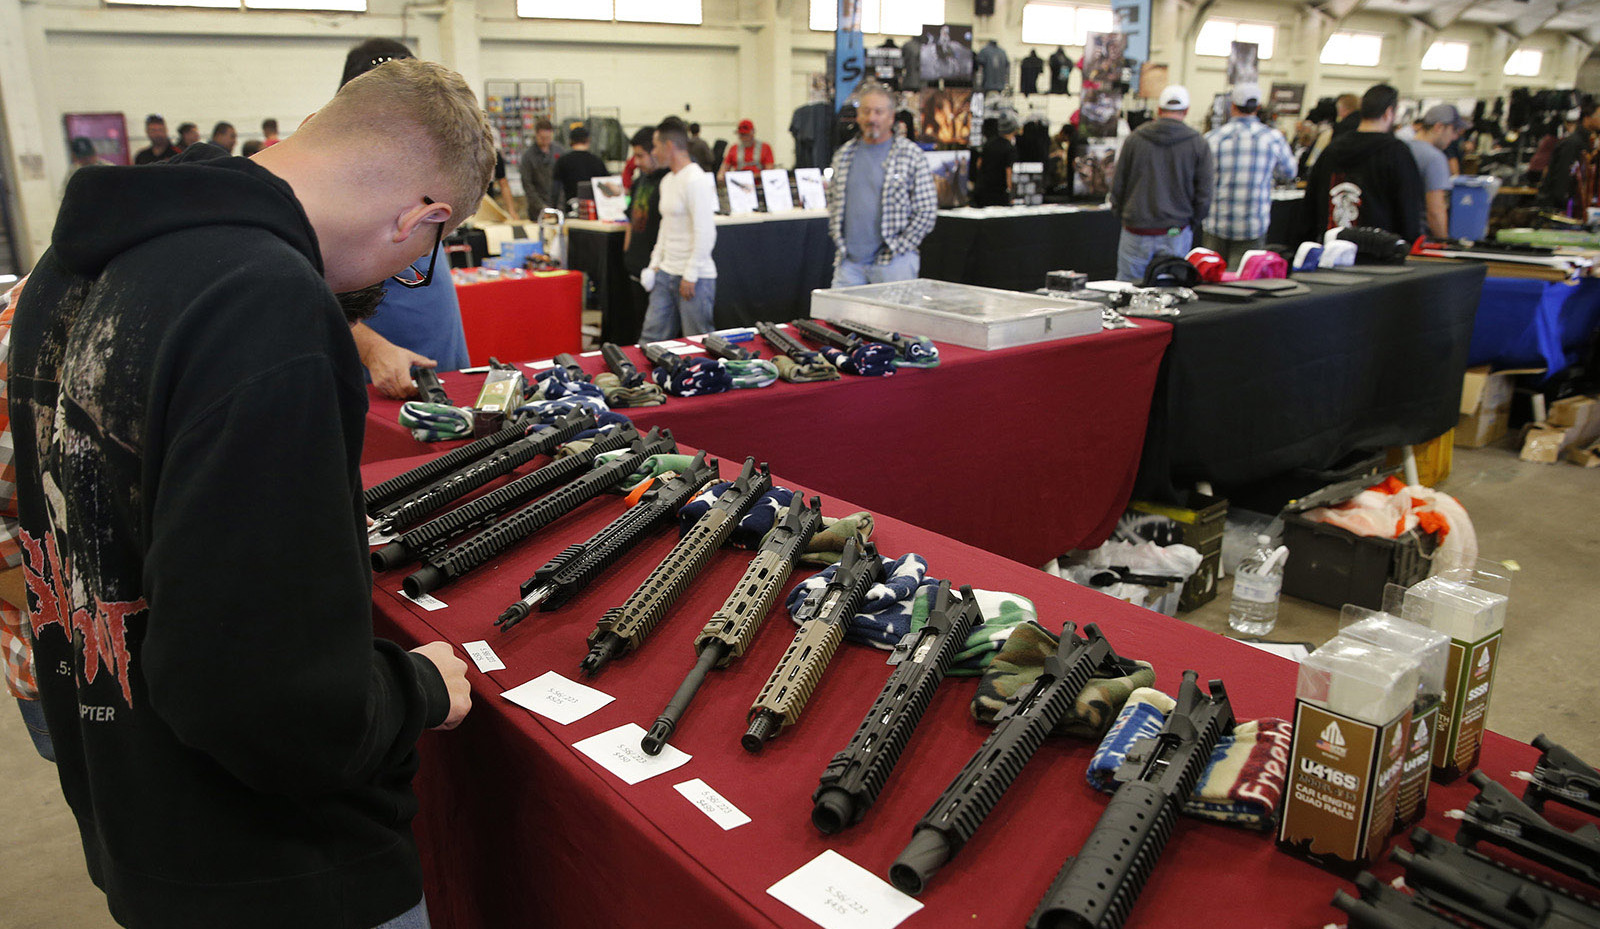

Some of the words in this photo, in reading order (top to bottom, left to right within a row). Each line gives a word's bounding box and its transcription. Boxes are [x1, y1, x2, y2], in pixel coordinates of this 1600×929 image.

[1300, 757, 1359, 791] U416S
[1294, 791, 1323, 809] QUAD
[1323, 803, 1355, 821] RAILS
[1295, 783, 1316, 798] CAR
[1316, 791, 1356, 813] LENGTH
